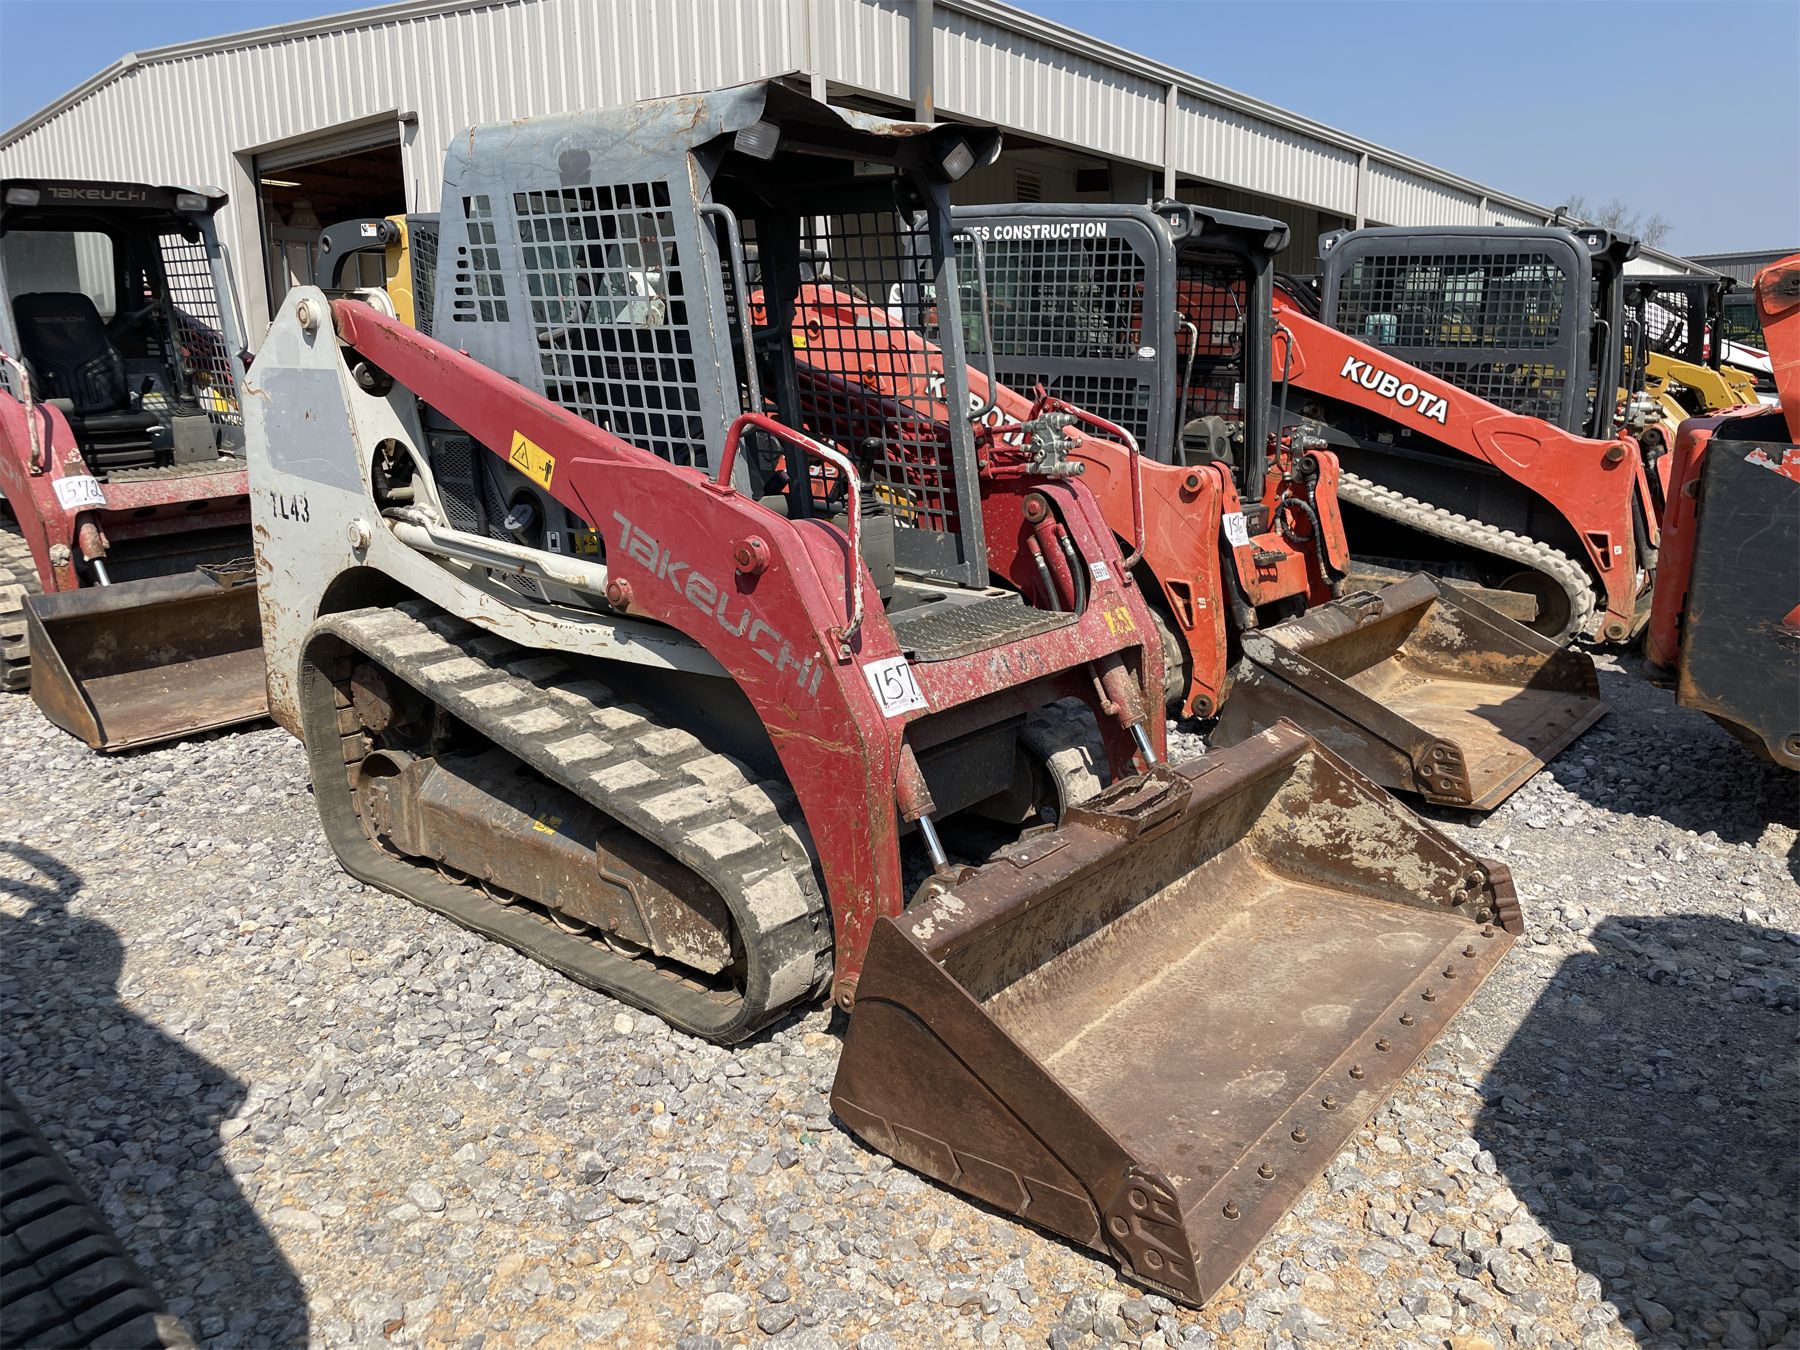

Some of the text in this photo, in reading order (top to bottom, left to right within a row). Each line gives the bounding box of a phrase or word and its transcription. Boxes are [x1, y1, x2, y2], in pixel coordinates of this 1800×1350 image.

[47, 187, 146, 201] TAKEUCHI
[994, 222, 1107, 240] CONSTRUCTION
[1341, 356, 1449, 424] KUBOTA
[270, 490, 310, 523] TL43
[613, 511, 824, 697] TAKEUCHI
